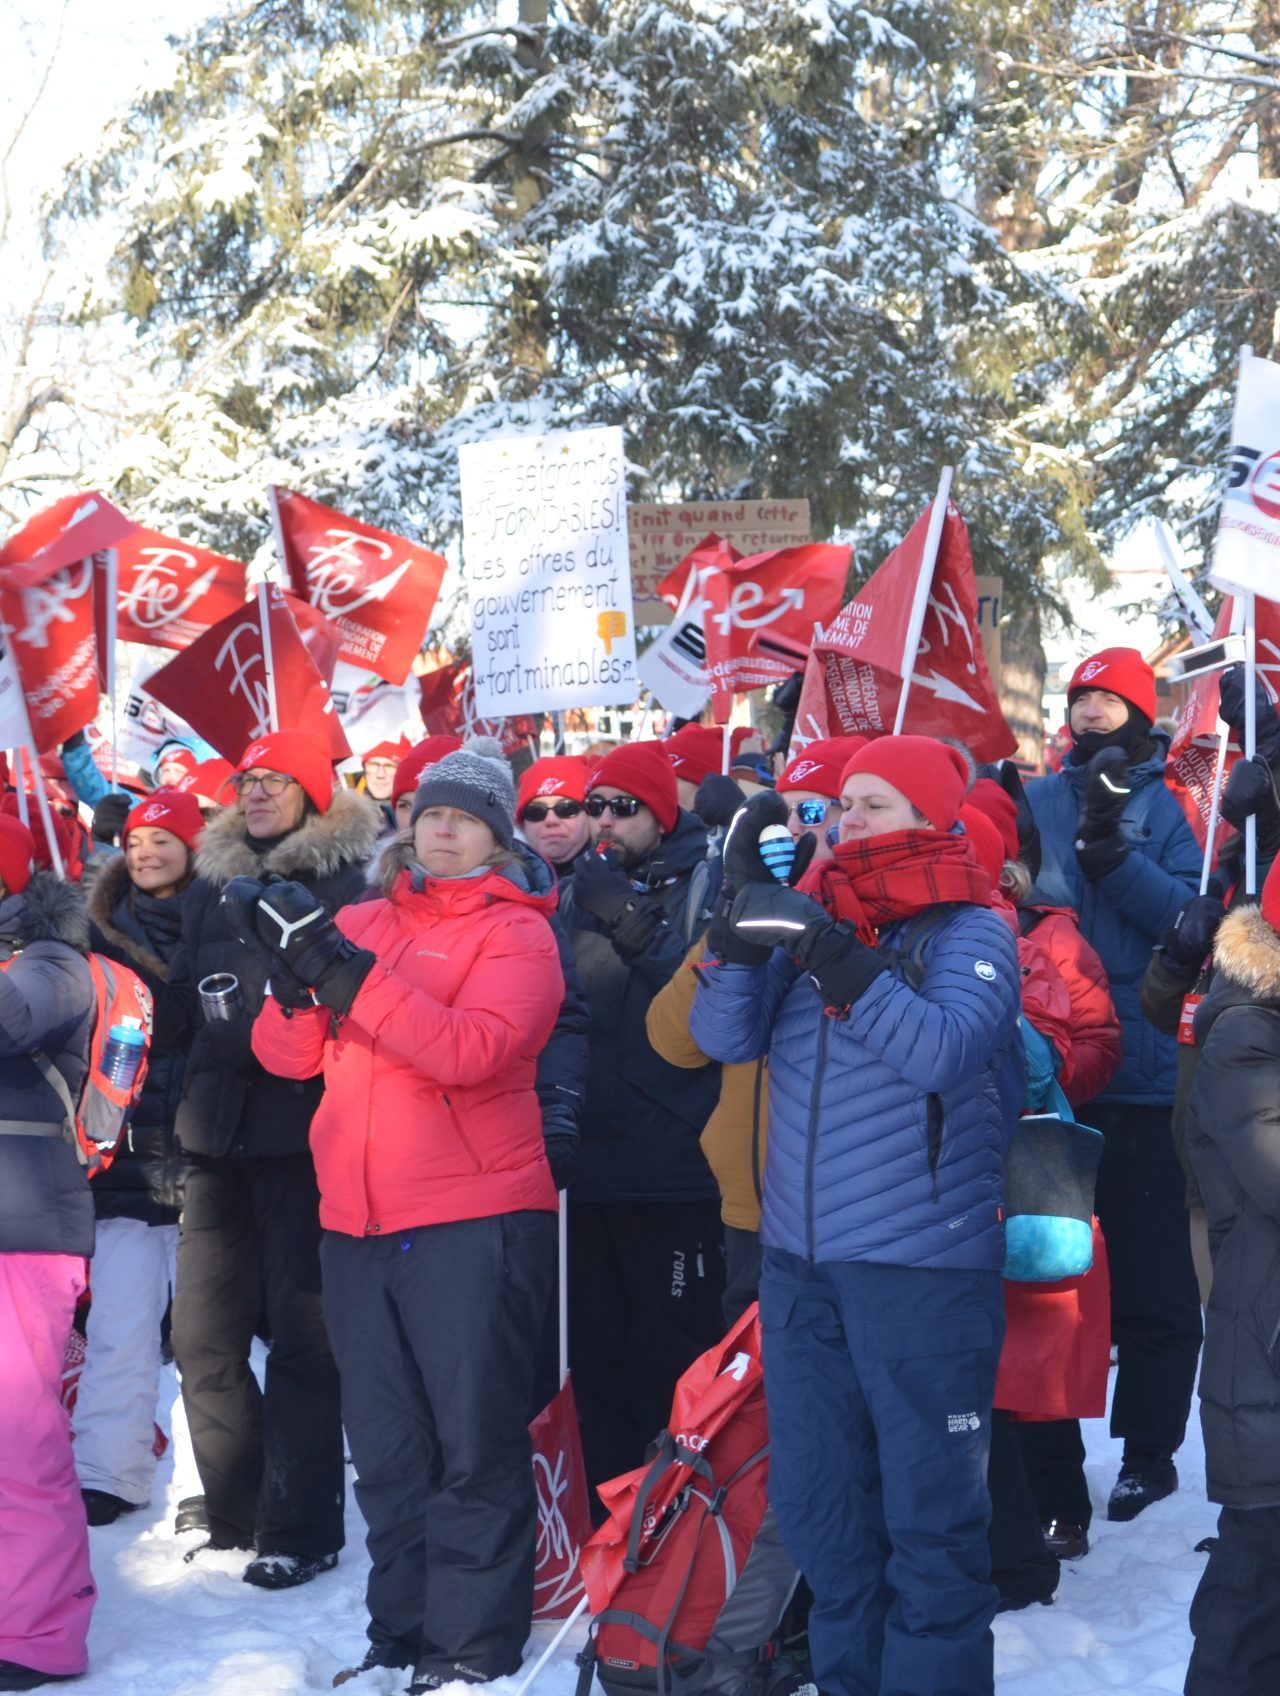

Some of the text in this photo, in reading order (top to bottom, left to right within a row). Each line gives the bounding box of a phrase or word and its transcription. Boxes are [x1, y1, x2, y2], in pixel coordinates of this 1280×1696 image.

[679, 504, 746, 527] quand
[472, 535, 614, 580] Les offres du
[474, 576, 618, 630] gouvernement
[488, 624, 520, 652] sont
[671, 1249, 686, 1298] roots
